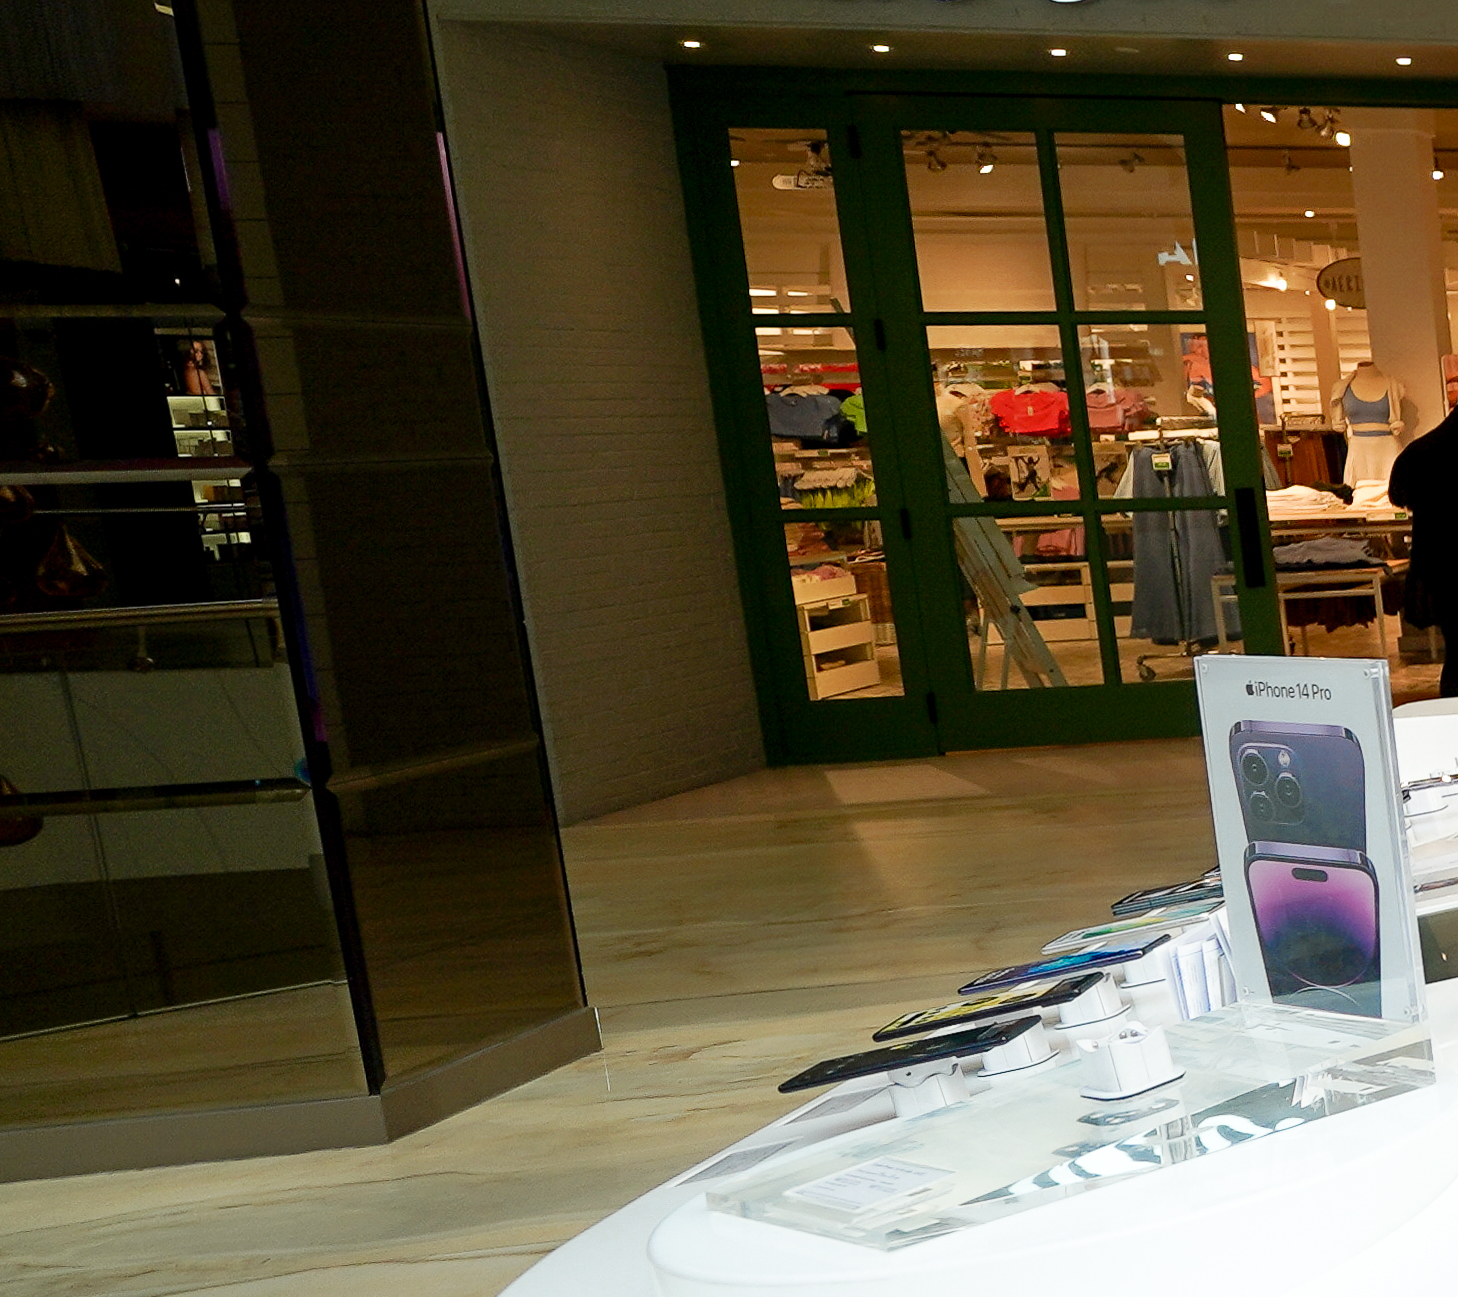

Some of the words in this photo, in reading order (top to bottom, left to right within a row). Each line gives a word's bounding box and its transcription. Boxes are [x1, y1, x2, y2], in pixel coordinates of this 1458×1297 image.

[1255, 681, 1295, 699] iPhone
[1296, 683, 1309, 700] 14
[1312, 684, 1332, 701] Pro
